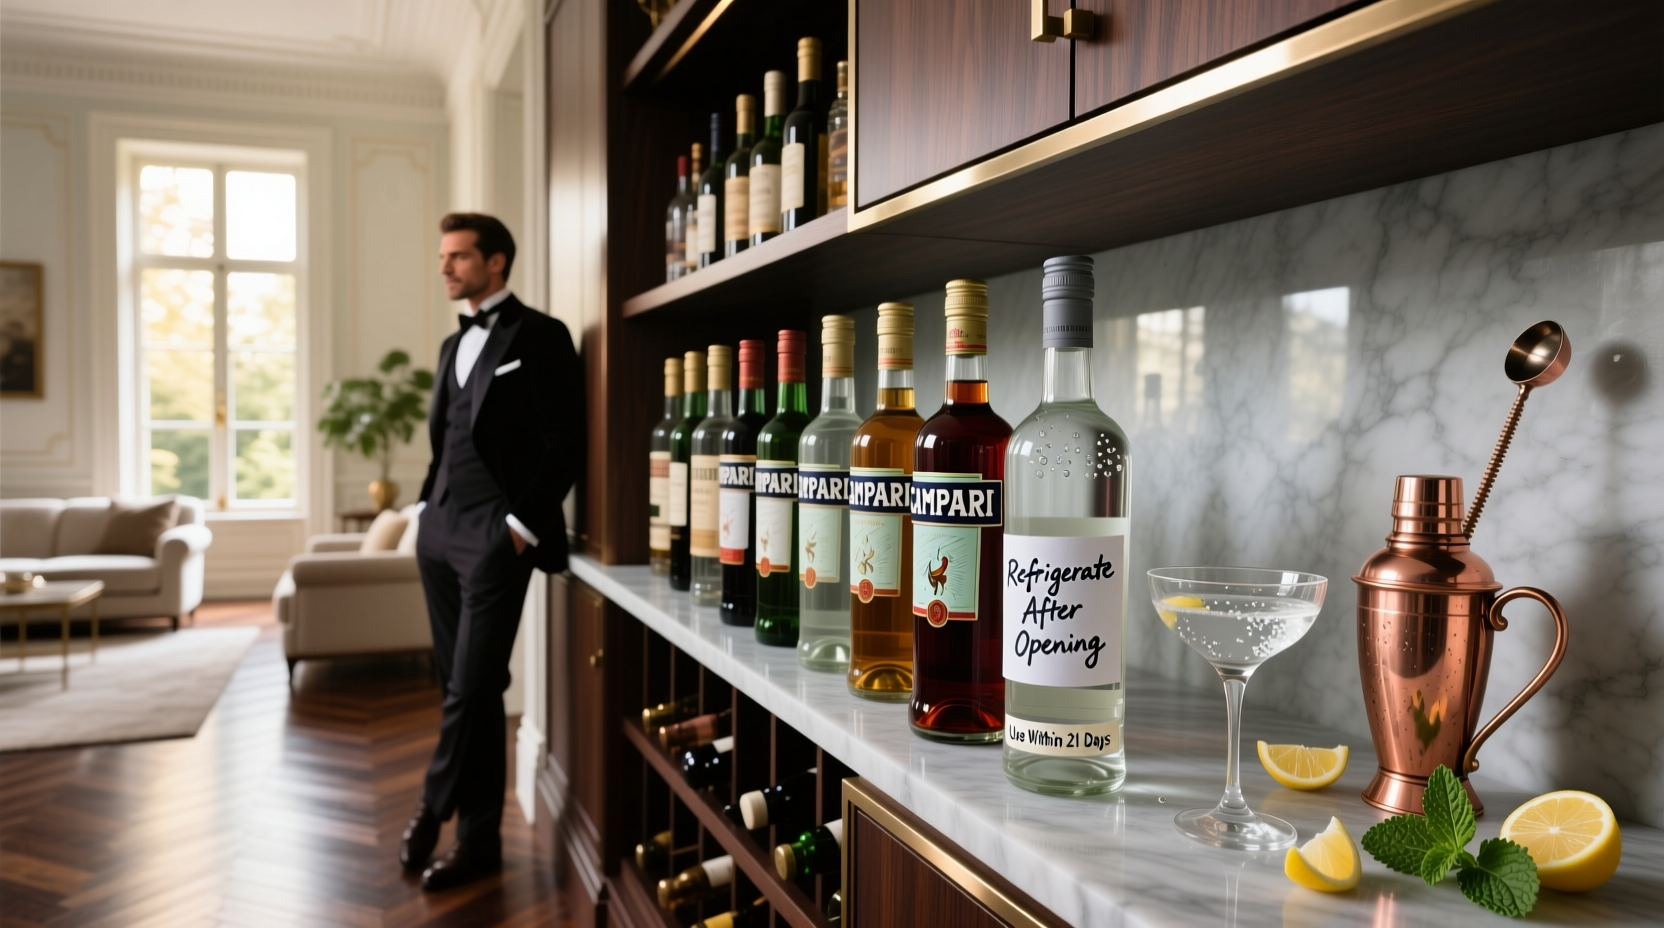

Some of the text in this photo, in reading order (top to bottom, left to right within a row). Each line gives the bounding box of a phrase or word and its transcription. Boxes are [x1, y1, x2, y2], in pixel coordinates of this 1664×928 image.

[1007, 554, 1115, 596] Refrigerate
[1021, 596, 1083, 629] After
[1014, 629, 1106, 669] Opening
[1010, 724, 1026, 742] Use
[1066, 732, 1080, 748] 21
[1084, 732, 1111, 751] Days
